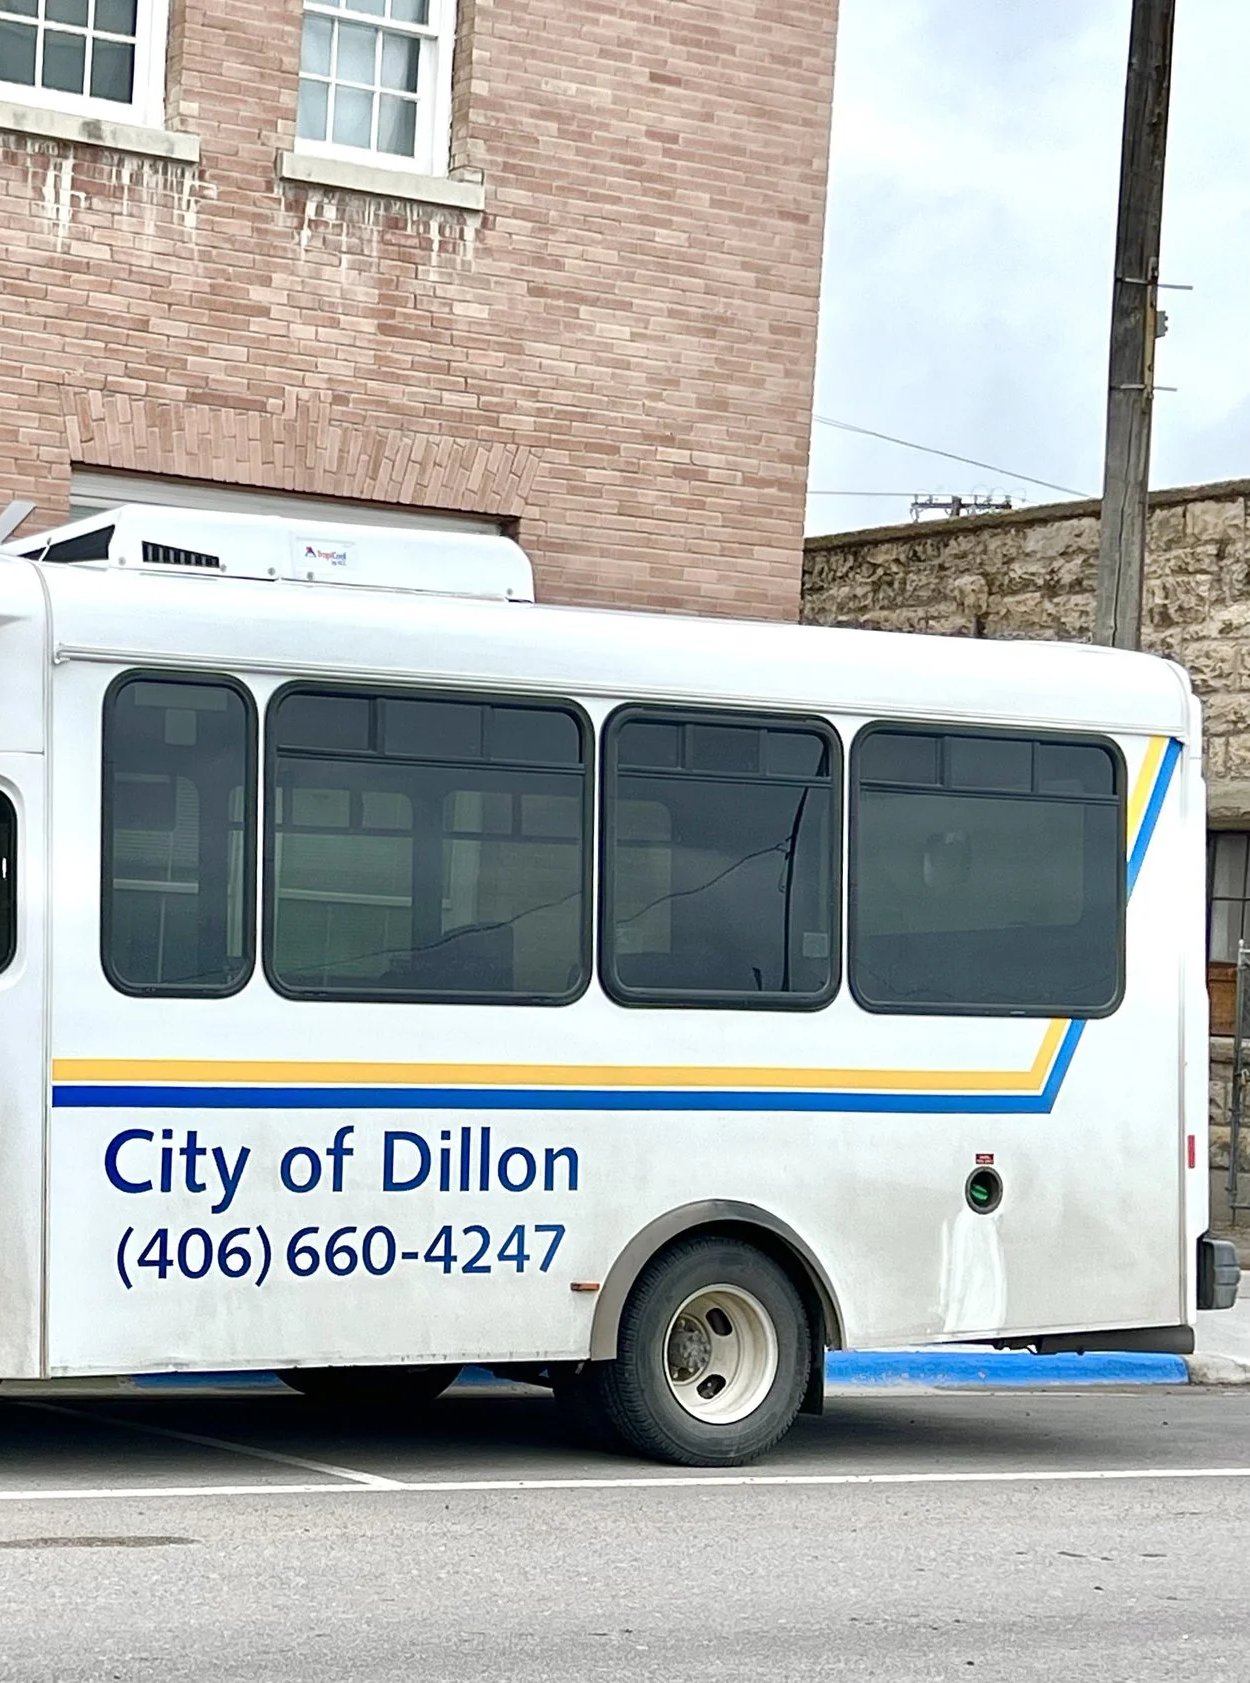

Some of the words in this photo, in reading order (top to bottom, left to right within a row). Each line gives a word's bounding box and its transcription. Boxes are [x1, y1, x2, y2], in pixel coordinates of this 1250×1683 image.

[104, 1128, 251, 1214] City
[279, 1125, 355, 1193] of
[382, 1126, 580, 1192] Dillon
[116, 1225, 272, 1290] (406)
[285, 1224, 567, 1278] 660-4247
